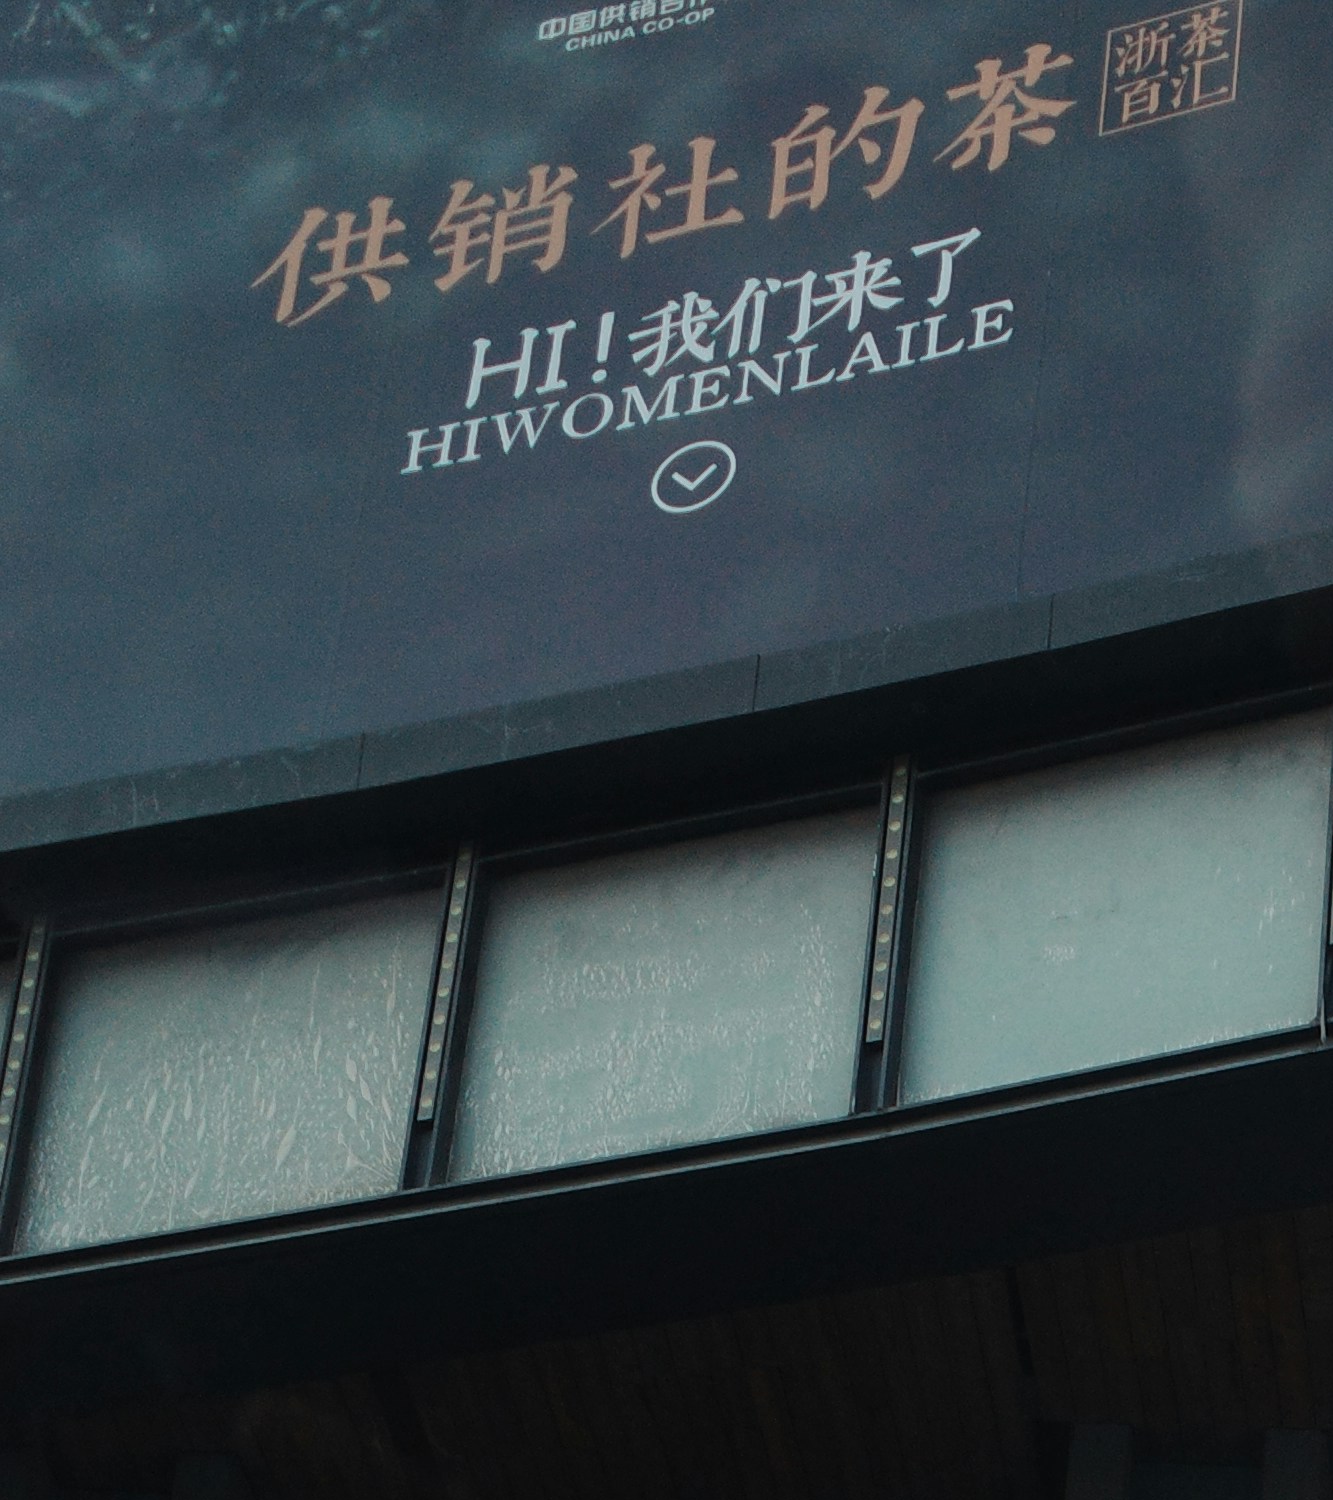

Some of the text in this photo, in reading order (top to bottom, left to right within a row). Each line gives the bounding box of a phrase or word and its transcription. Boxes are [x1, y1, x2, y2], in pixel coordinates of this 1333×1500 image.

[565, 7, 715, 51] CHINA CO-OP
[251, 43, 1077, 328] 供销社的茶
[400, 299, 1014, 475] HIWOMENLAILE
